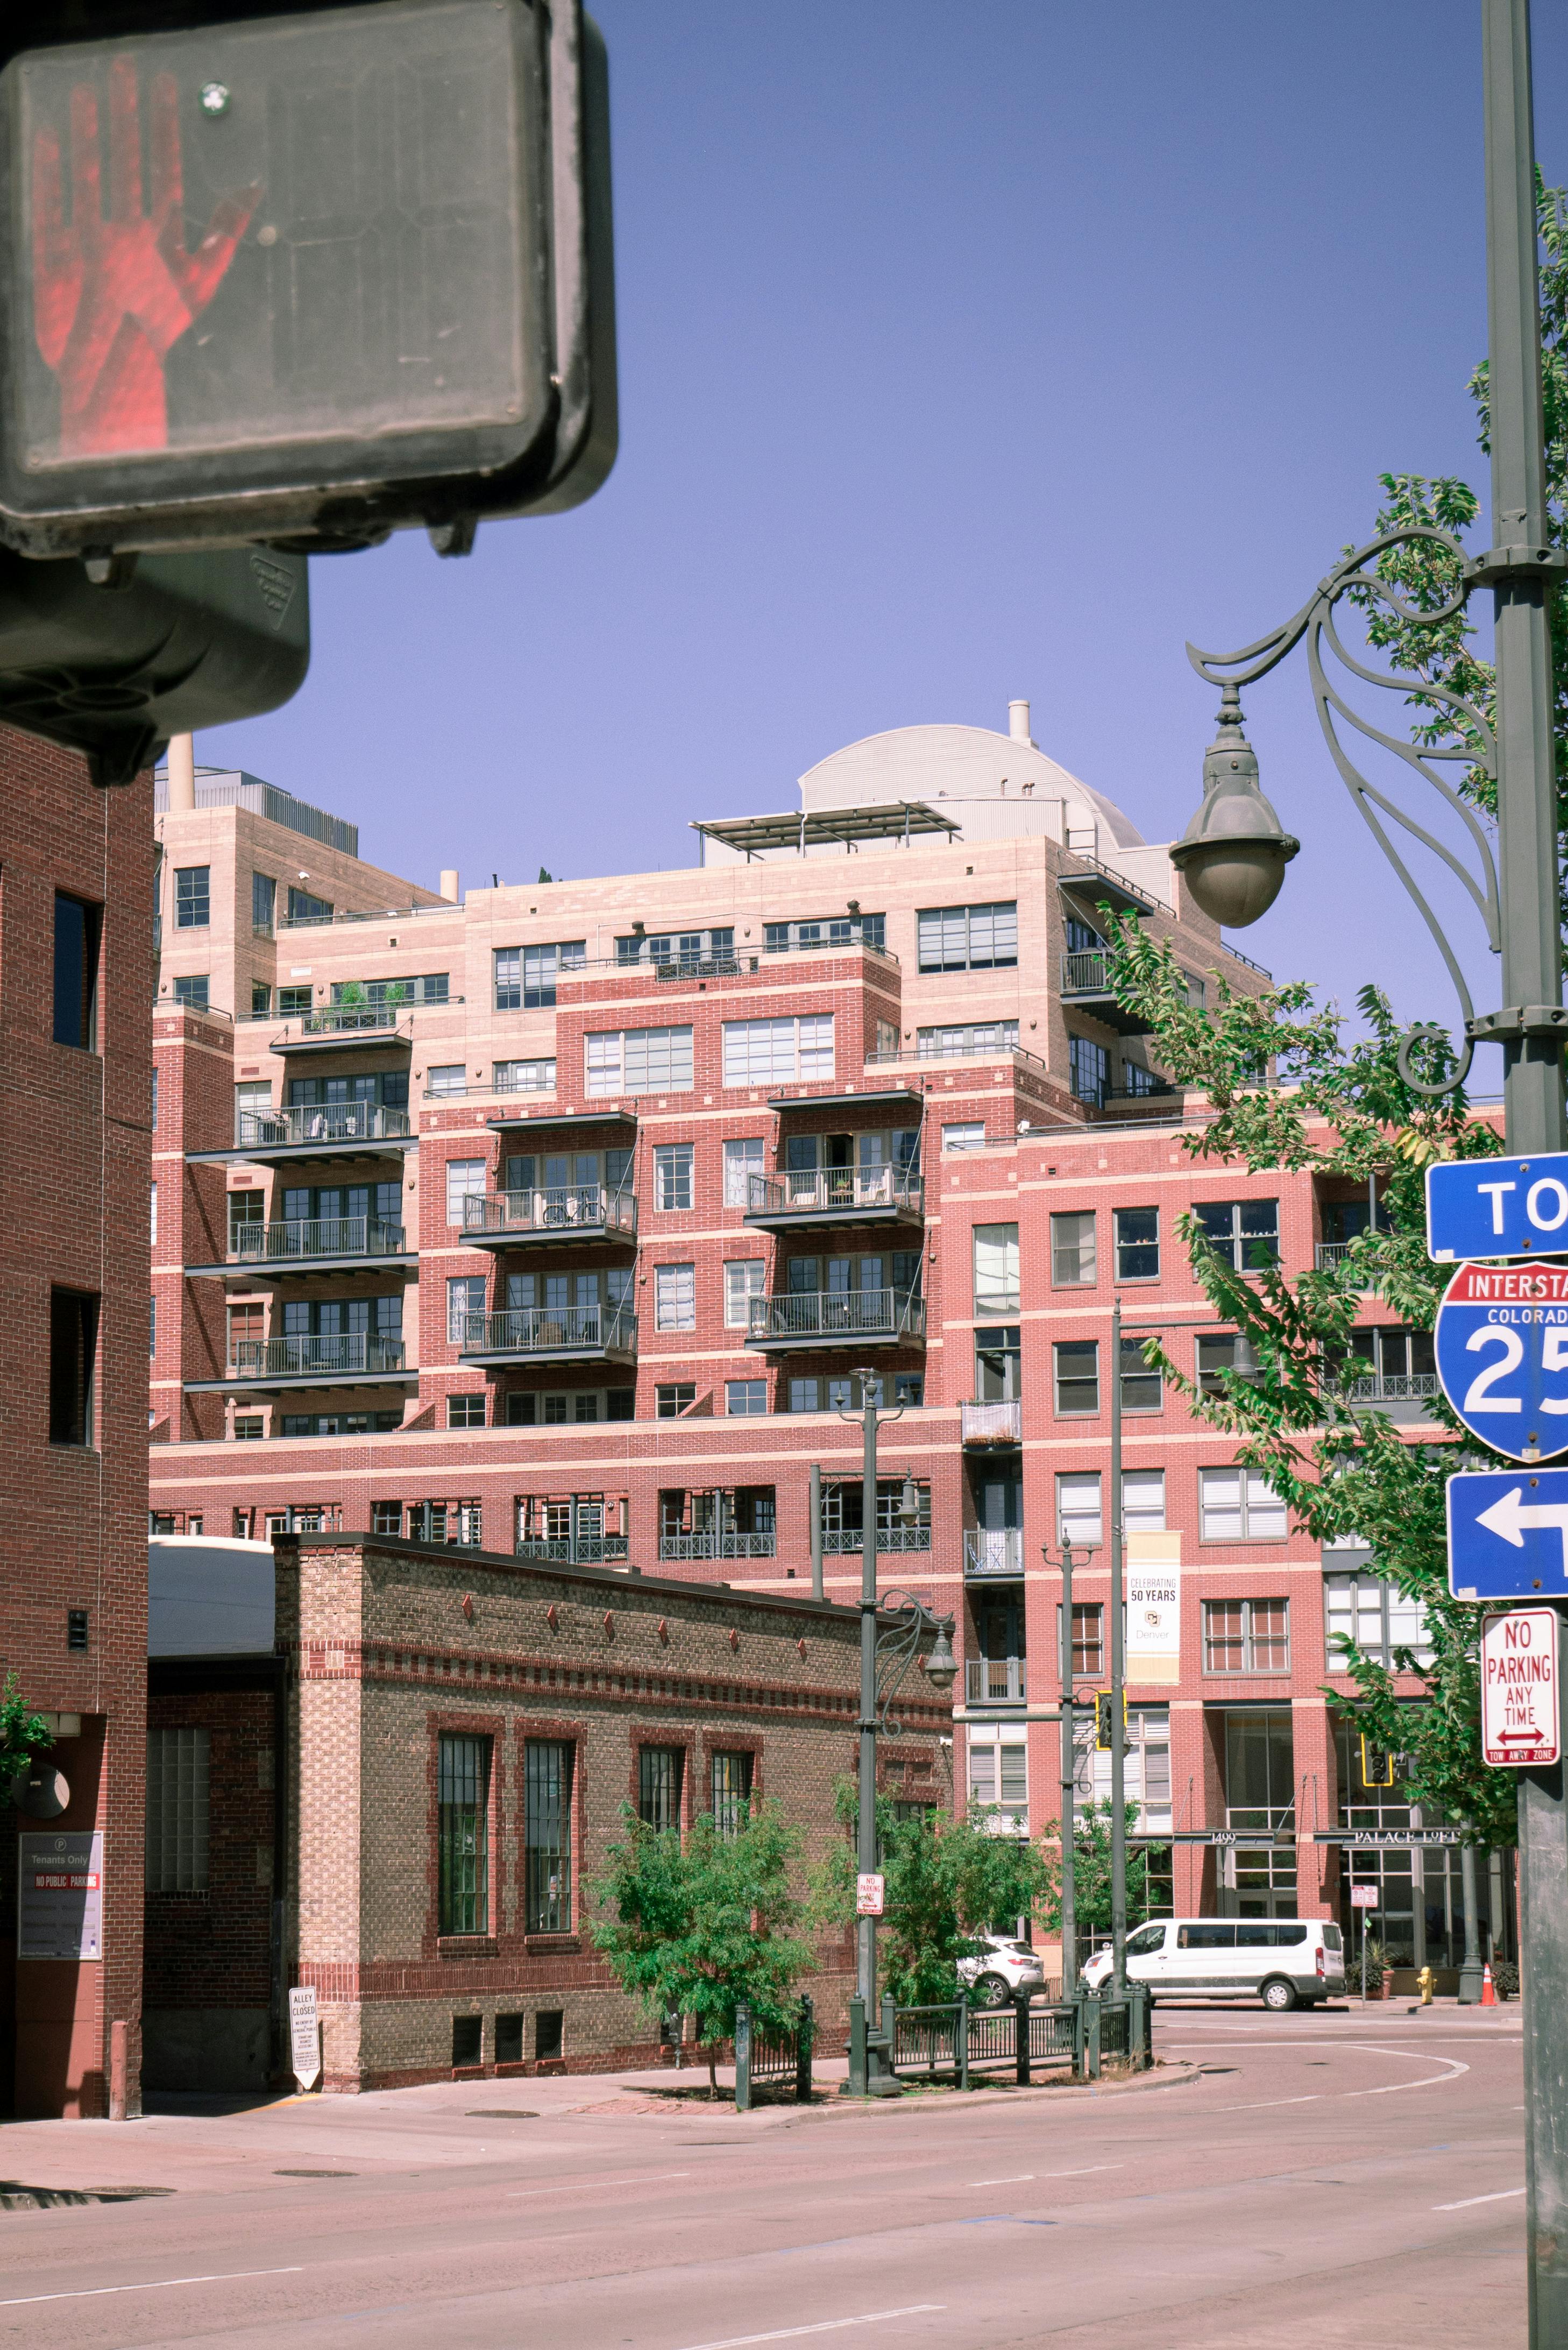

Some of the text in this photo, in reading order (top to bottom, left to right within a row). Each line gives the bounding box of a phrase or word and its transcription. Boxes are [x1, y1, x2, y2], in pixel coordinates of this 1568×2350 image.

[1478, 1177, 1568, 1234] TO
[1131, 1578, 1176, 1588] CELEBRATING
[1131, 1590, 1175, 1601] 50 YEARS
[1137, 1630, 1169, 1639] Denver
[1505, 1621, 1531, 1649] NO
[1488, 1655, 1550, 1684] PARKING
[1507, 1687, 1532, 1705] ANY
[1505, 1707, 1535, 1725] TIME
[1489, 1752, 1504, 1761] TOW
[1533, 1750, 1553, 1760] ZONE
[1212, 1832, 1236, 1844] 1499
[1355, 1831, 1416, 1843] PALACE
[32, 1855, 88, 1866] Tenants Only
[36, 1875, 96, 1887] NO PUBLIC PARKING
[860, 1885, 881, 1893] PARKING
[294, 1994, 312, 2004] ALLEY
[293, 2006, 315, 2016] CLOSED
